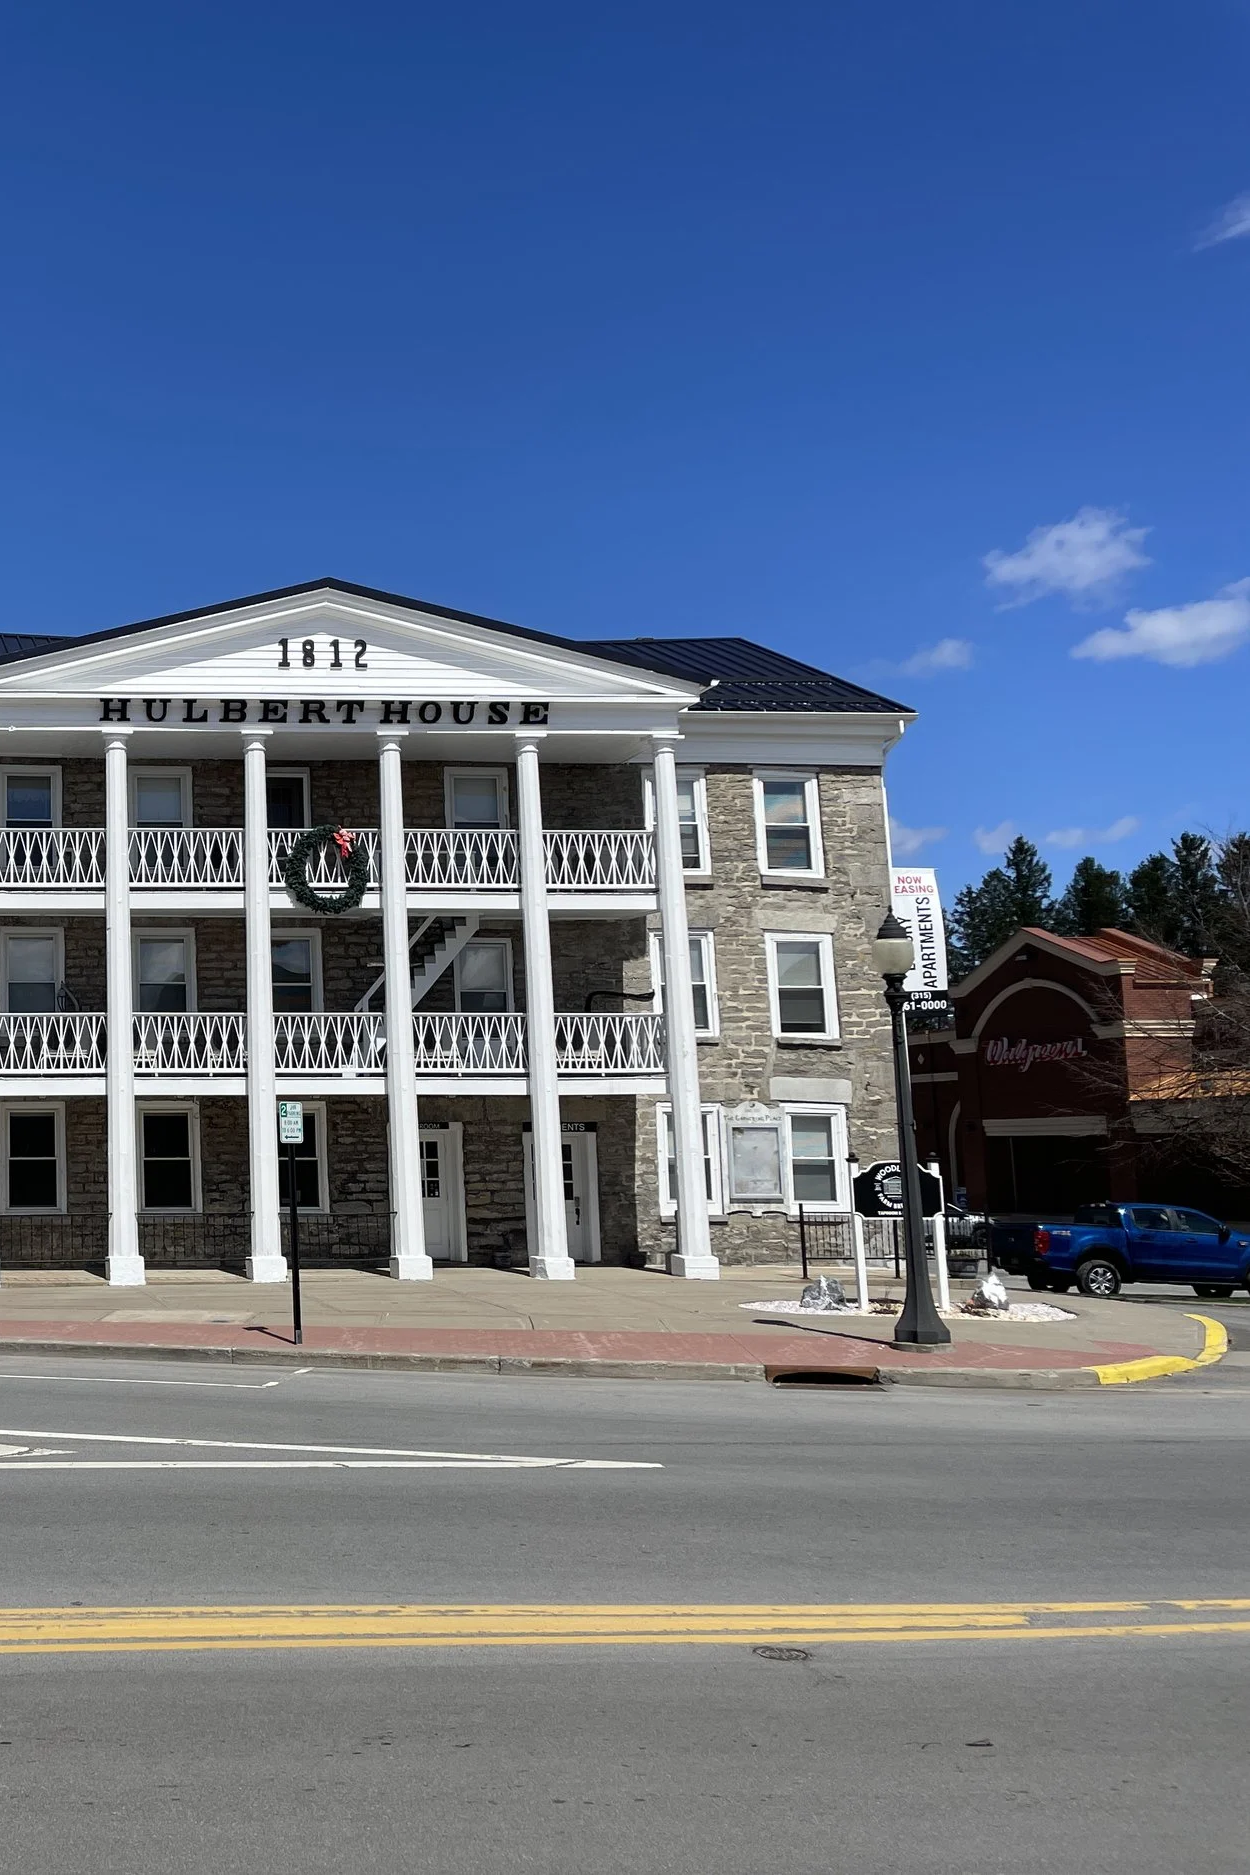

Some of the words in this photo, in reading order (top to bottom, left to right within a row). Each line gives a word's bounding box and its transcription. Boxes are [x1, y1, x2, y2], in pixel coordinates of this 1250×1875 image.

[278, 638, 367, 668] 1812
[99, 699, 364, 724] HULBERT
[379, 700, 549, 725] HOUSE
[897, 876, 922, 884] NOW
[894, 885, 934, 894] EASING
[915, 896, 938, 989] APARTMENTS
[911, 992, 932, 1000] (315)
[903, 1000, 947, 1011] 61-0000
[281, 1105, 287, 1116] 2
[874, 1164, 901, 1181] WOODL
